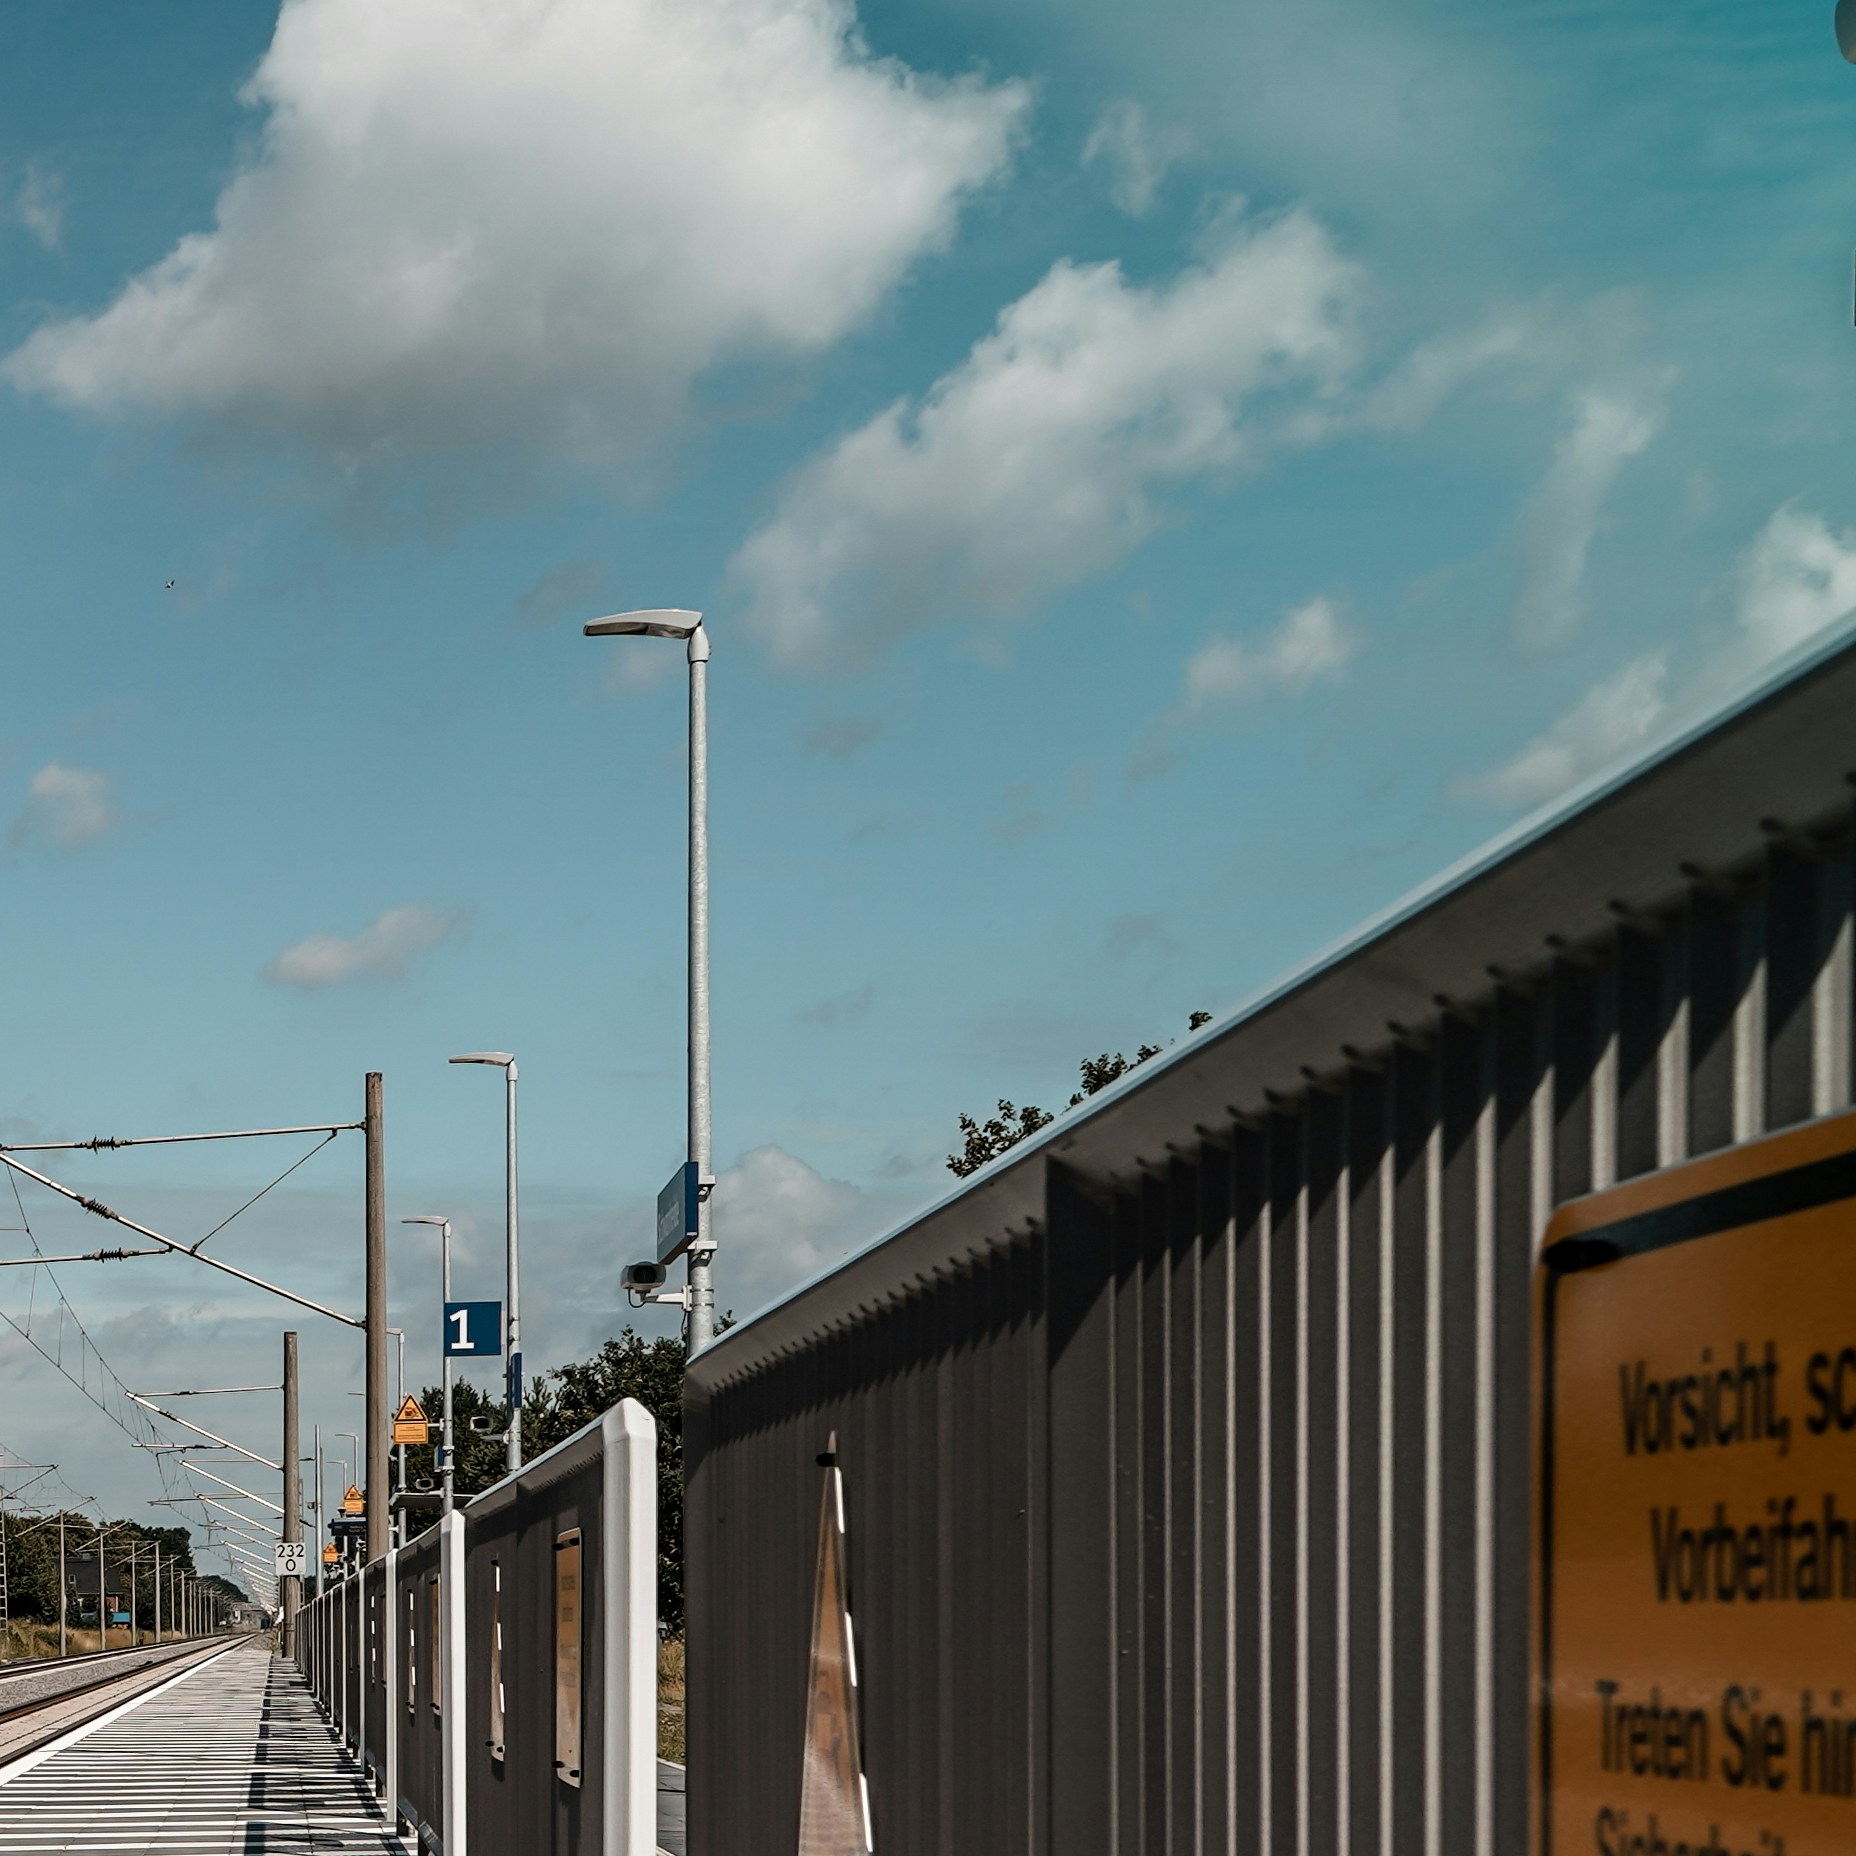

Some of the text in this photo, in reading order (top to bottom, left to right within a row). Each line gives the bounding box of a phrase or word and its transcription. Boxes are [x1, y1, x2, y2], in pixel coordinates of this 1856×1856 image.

[449, 1309, 475, 1350] 1
[1618, 1339, 1792, 1458] Vorsicht,
[276, 1544, 304, 1558] 232
[285, 1558, 297, 1572] 0
[1649, 1493, 1856, 1604] Vorbeifah
[1595, 1680, 1709, 1780] Treten
[1721, 1685, 1785, 1791] Sie
